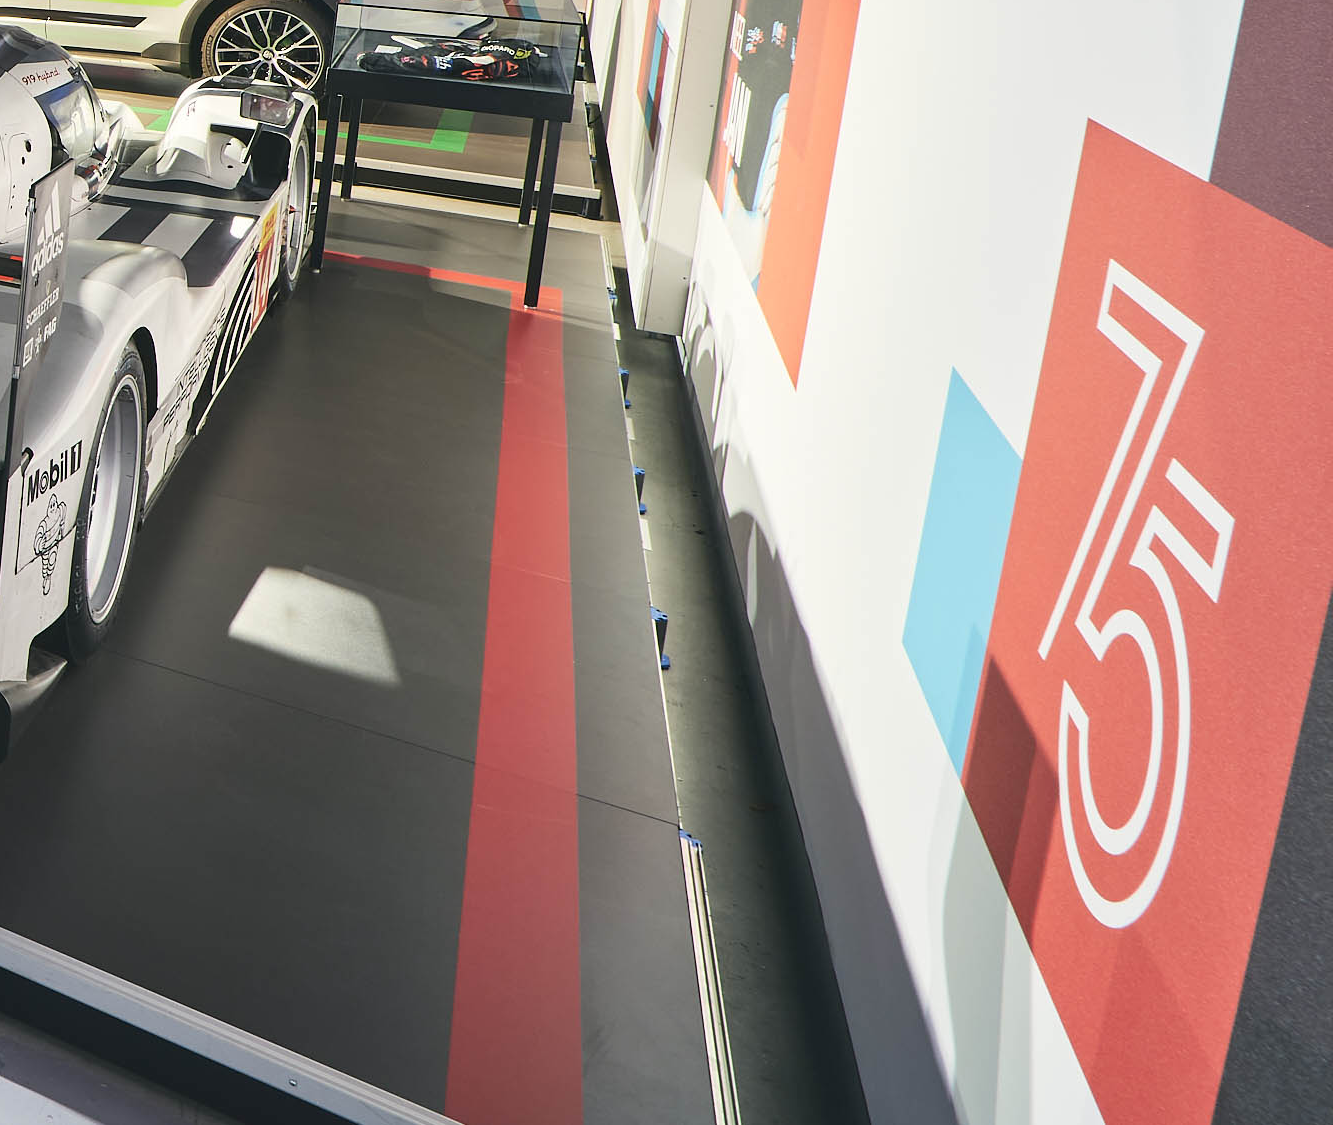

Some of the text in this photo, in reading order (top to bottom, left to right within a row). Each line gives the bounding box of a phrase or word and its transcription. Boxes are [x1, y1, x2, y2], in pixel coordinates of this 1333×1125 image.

[21, 66, 59, 86] 919 hybrid
[32, 232, 64, 277] adidas
[26, 287, 60, 330] SCHAEFFLER
[44, 316, 57, 343] FAG
[27, 440, 83, 507] Mobil 1
[1038, 257, 1236, 930] 75
